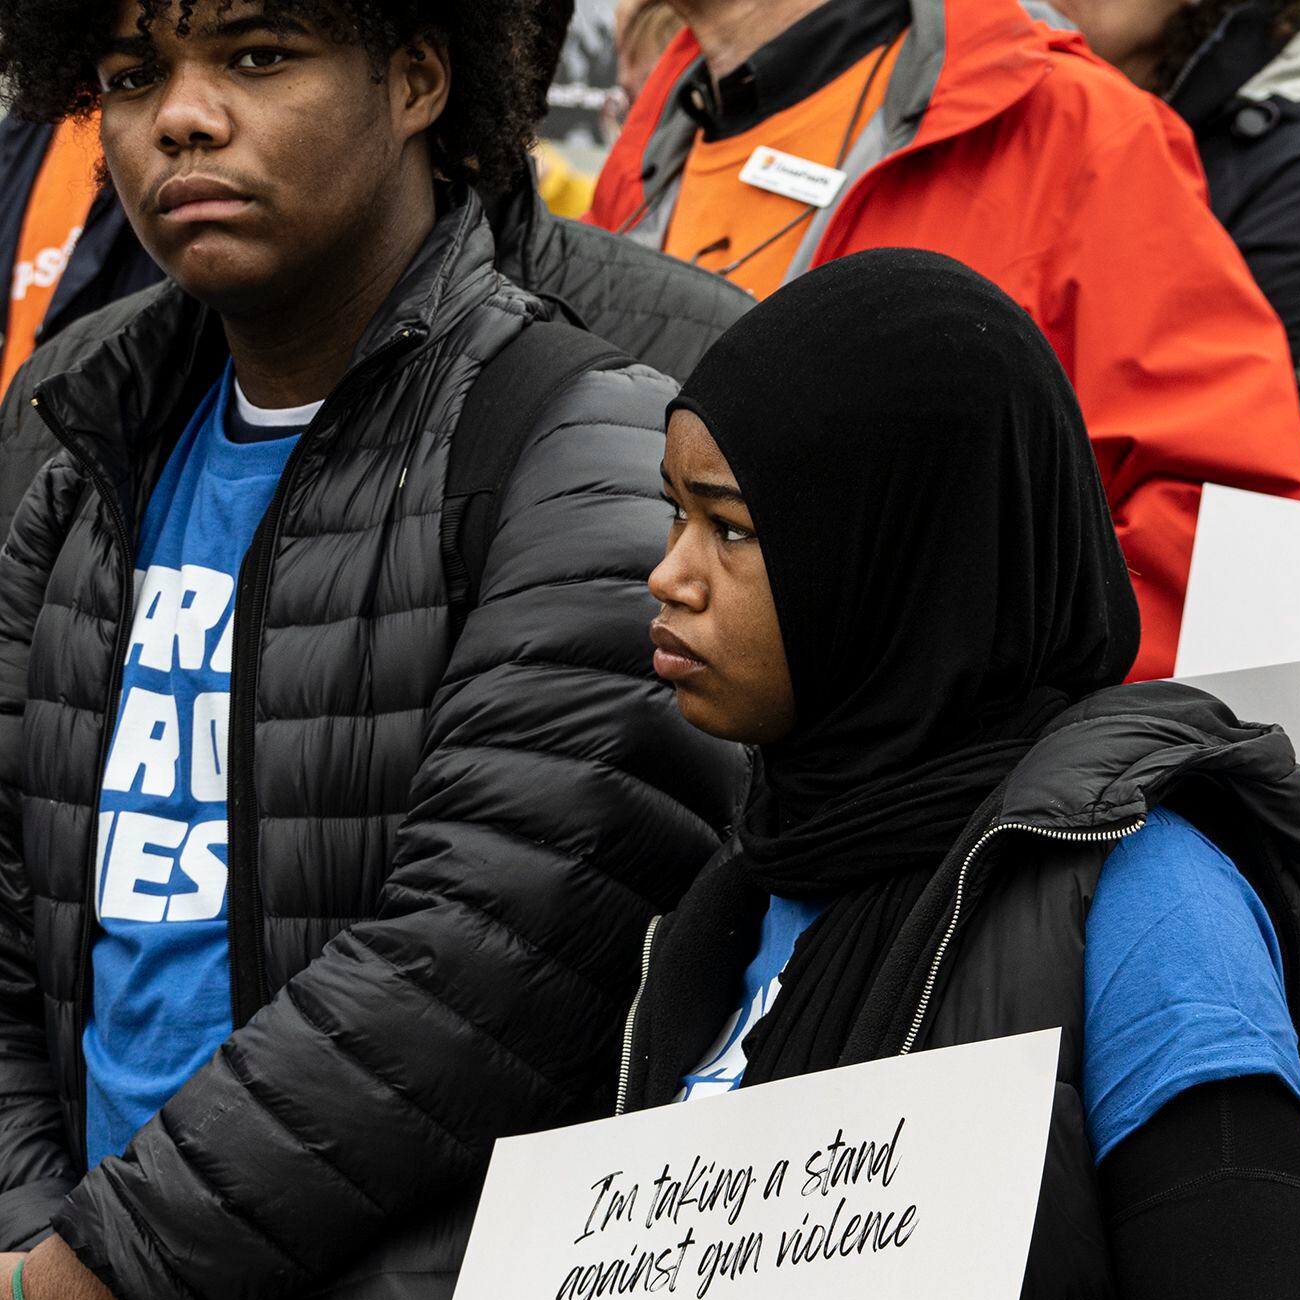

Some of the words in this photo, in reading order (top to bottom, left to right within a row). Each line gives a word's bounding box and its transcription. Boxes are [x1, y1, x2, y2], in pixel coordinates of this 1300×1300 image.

[645, 1154, 759, 1232] taking
[763, 1155, 790, 1199] a
[800, 1117, 907, 1198] stand
[695, 1228, 766, 1300] gun
[775, 1198, 921, 1271] violence
